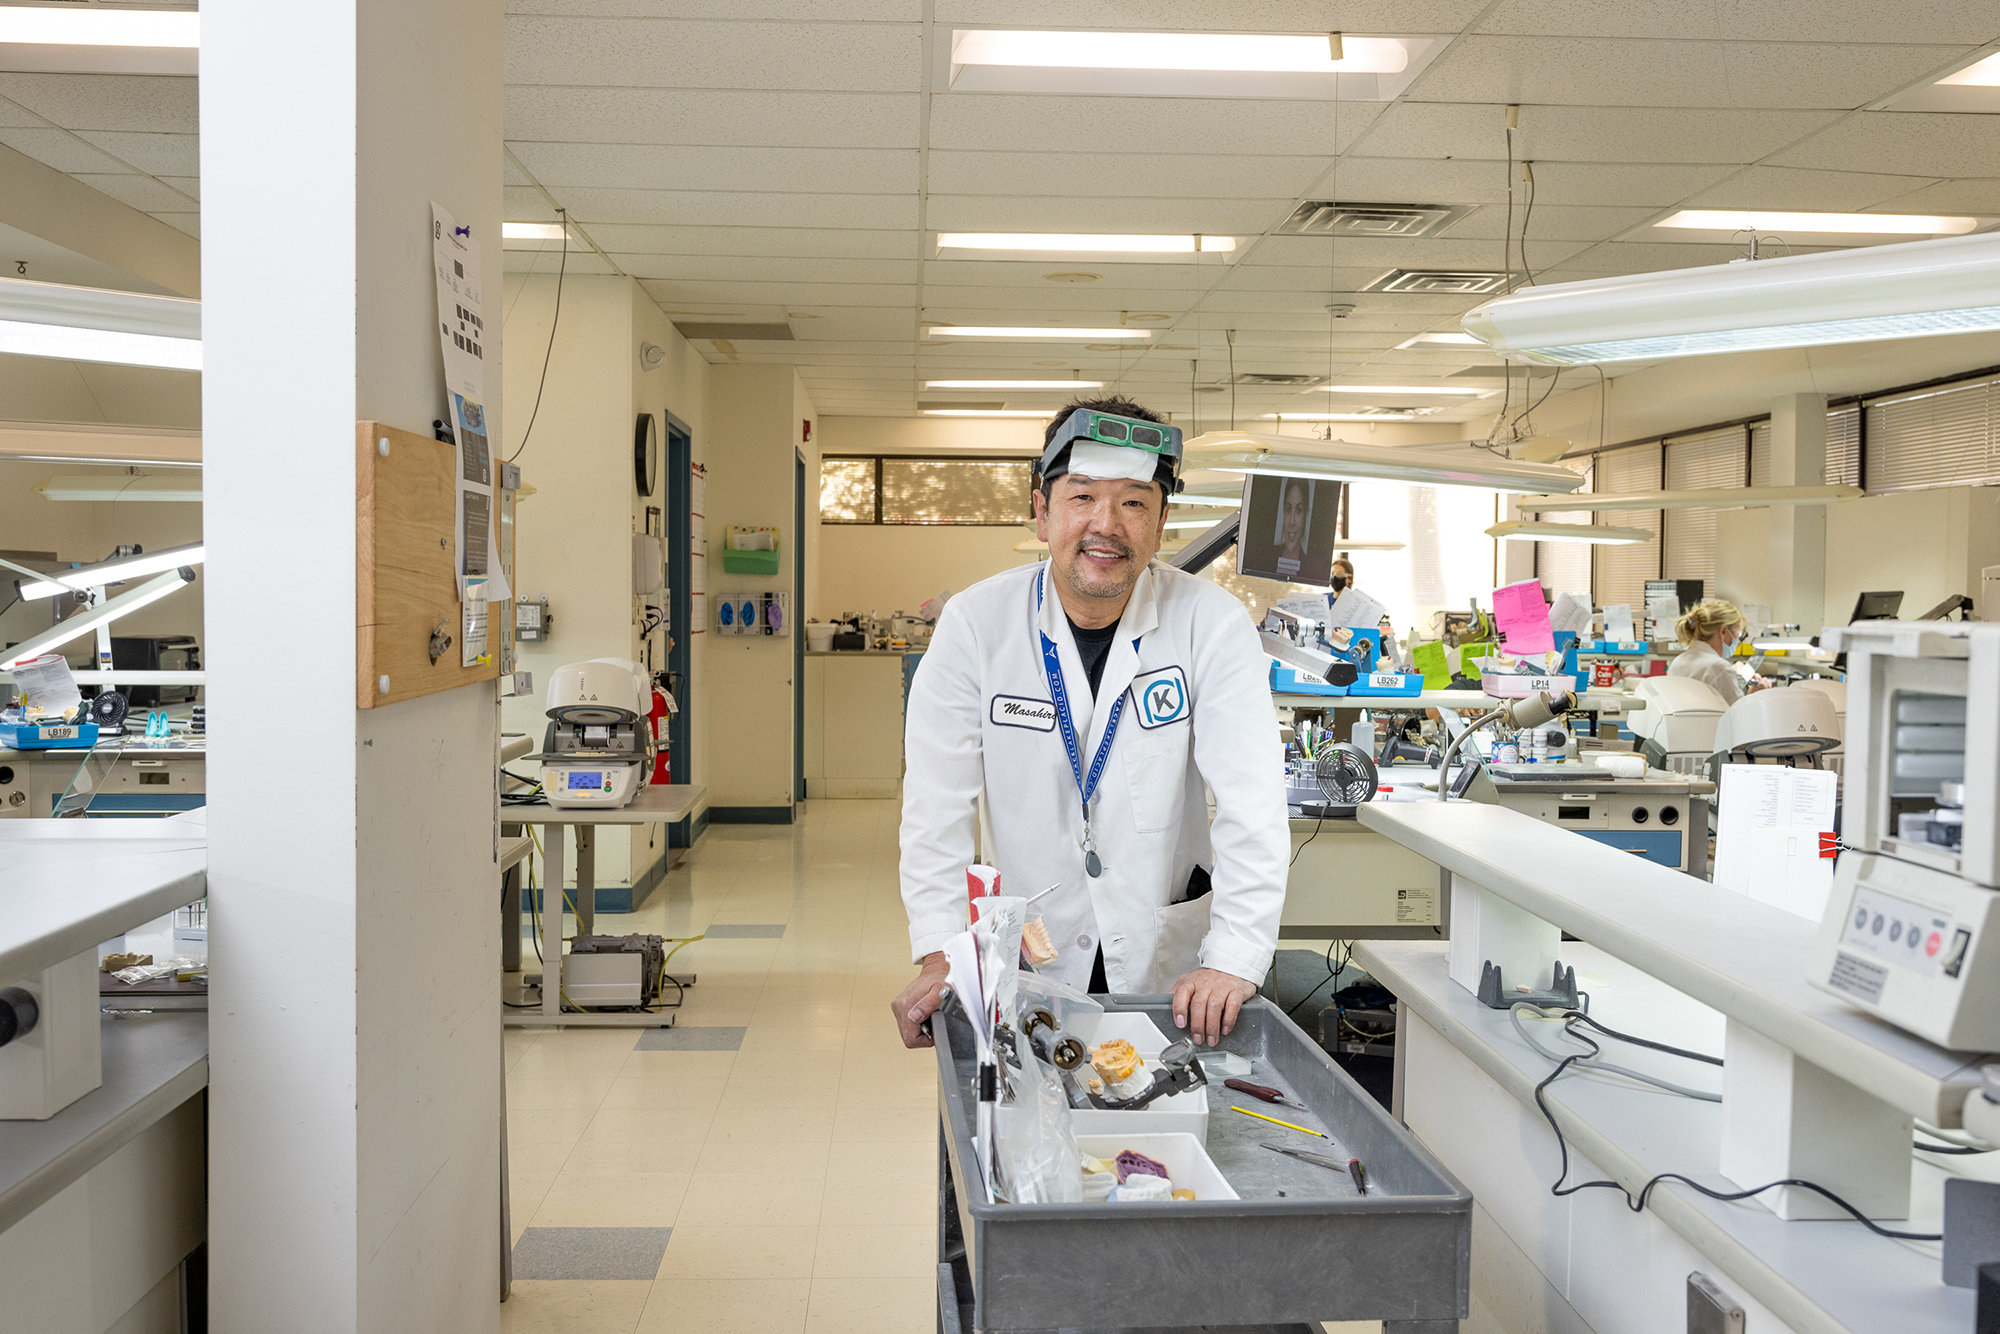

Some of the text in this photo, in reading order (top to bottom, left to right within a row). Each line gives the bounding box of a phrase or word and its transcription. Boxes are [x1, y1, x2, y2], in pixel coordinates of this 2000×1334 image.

[1377, 676, 1399, 685] LB262
[1531, 679, 1550, 687] LP14
[1153, 688, 1175, 714] K
[1003, 702, 1056, 720] Masahiro
[47, 728, 72, 736] LB189
